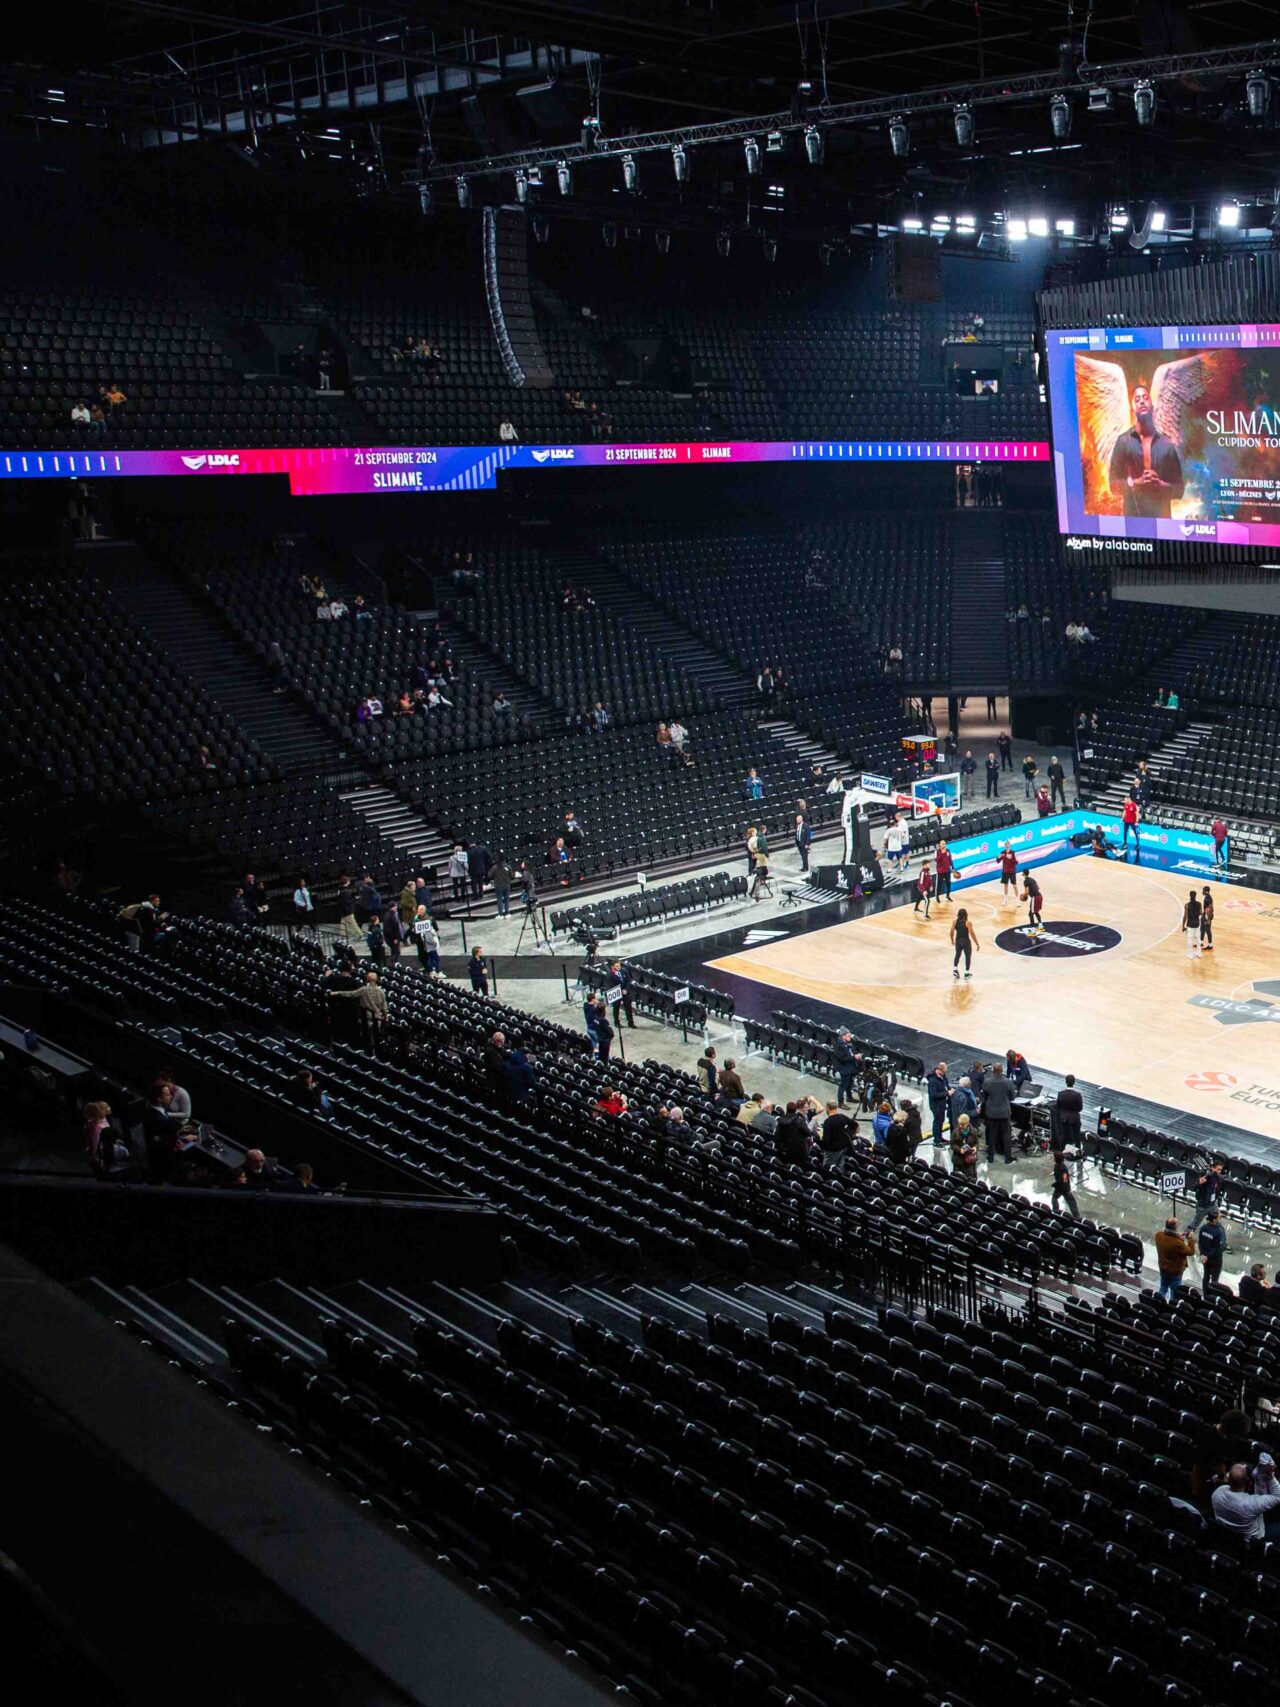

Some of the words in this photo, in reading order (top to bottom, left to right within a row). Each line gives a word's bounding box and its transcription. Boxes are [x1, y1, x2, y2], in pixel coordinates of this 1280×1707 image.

[1217, 437, 1261, 448] CUPIDON
[354, 453, 364, 465] 21
[366, 453, 414, 465] SEPTEMBRE
[416, 452, 437, 464] 2024
[551, 449, 574, 459] LDLC
[606, 450, 615, 460] 21
[616, 449, 657, 460] SEPTEMBRE
[659, 448, 677, 459] 2024
[702, 448, 731, 458] SLIMANE
[208, 454, 240, 466] LDLC
[374, 471, 424, 487] SLIMANE
[1220, 479, 1228, 487] 21
[1230, 479, 1274, 489] SEPTEMBRE
[1195, 525, 1216, 535] LDLC
[1093, 538, 1104, 550] by
[1105, 539, 1153, 551] alabama
[863, 778, 887, 789] SKWEEK
[417, 923, 429, 931] 010
[607, 989, 621, 1001] 008
[1200, 997, 1250, 1013] LDLC
[1165, 1177, 1184, 1188] 006
